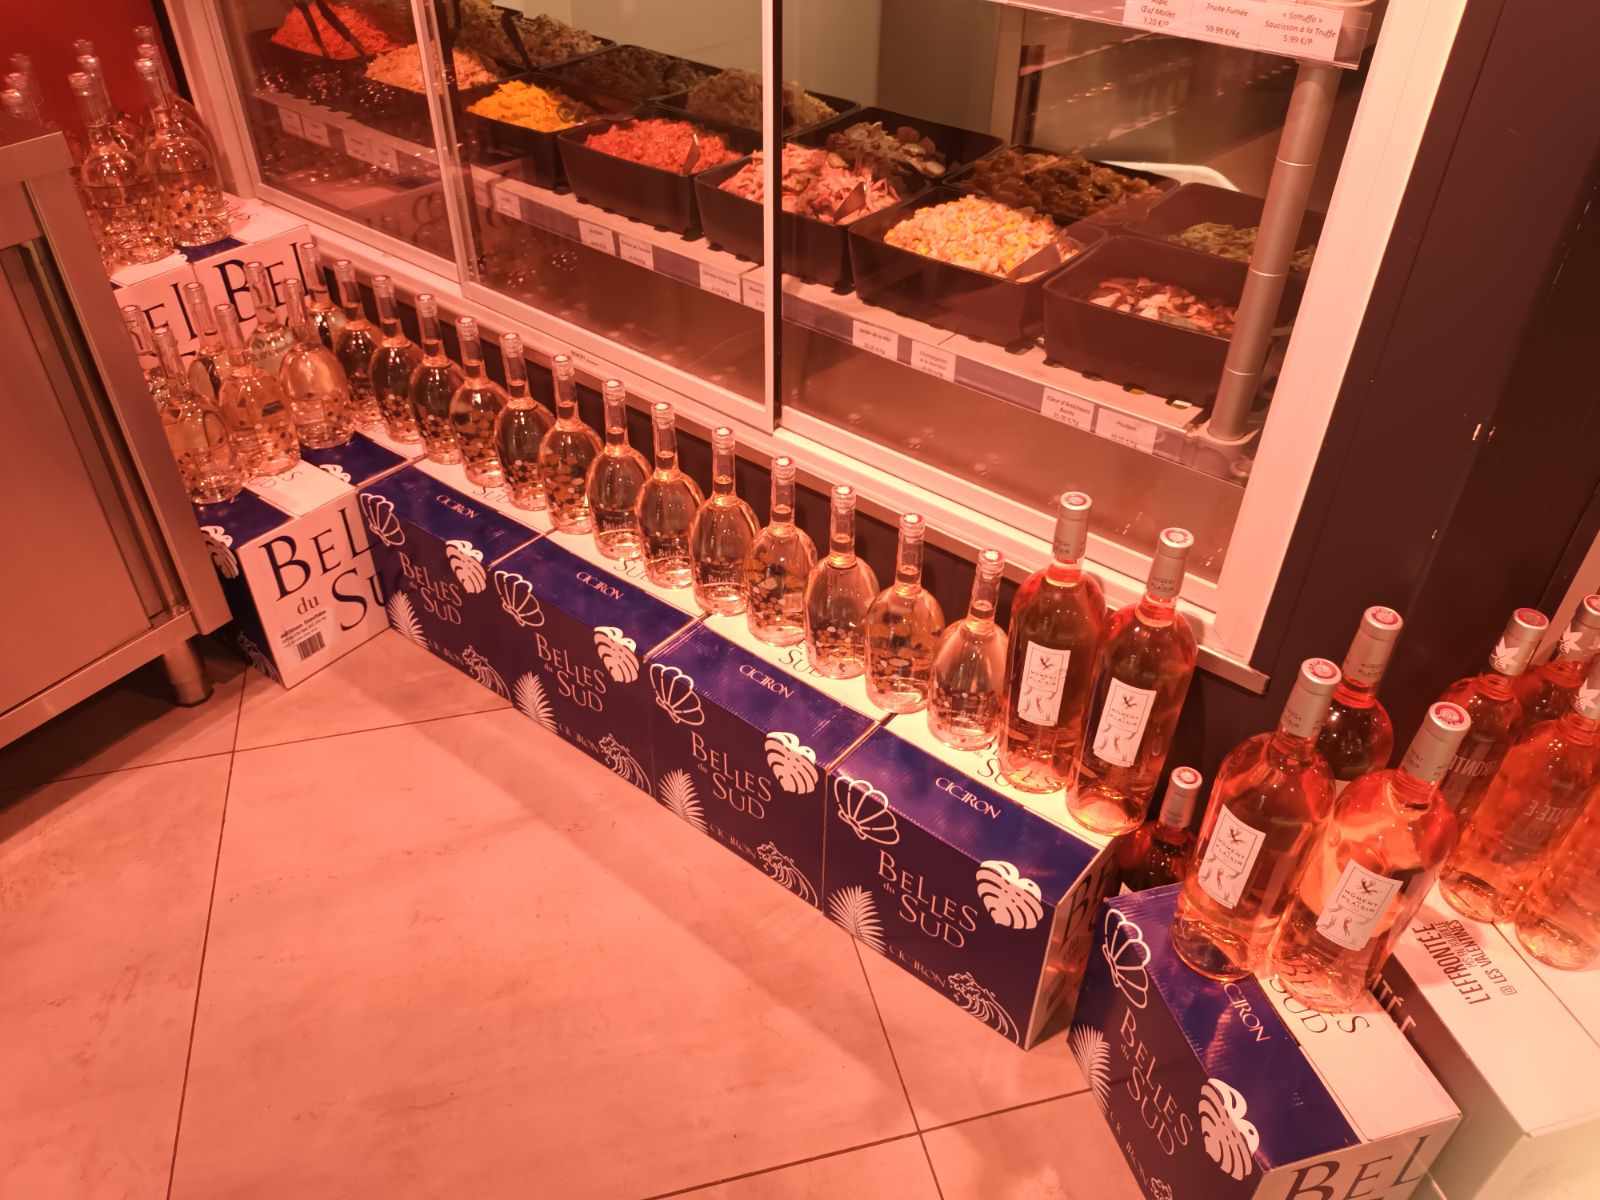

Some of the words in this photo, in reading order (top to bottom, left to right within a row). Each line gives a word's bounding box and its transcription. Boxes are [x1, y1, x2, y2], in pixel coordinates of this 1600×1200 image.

[296, 596, 320, 615] du
[399, 551, 463, 608] BELLES
[420, 586, 462, 625] SUD
[535, 632, 608, 696] BELLES
[556, 669, 604, 712] SUD
[690, 730, 772, 802] BELLES
[712, 772, 766, 820] SUD
[878, 849, 978, 932] BELLES
[899, 893, 965, 948] SUD
[1446, 919, 1492, 968] VALENTINES
[1485, 968, 1508, 984] LES
[1120, 1007, 1194, 1146] BELLES
[1126, 1066, 1175, 1156] SUD
